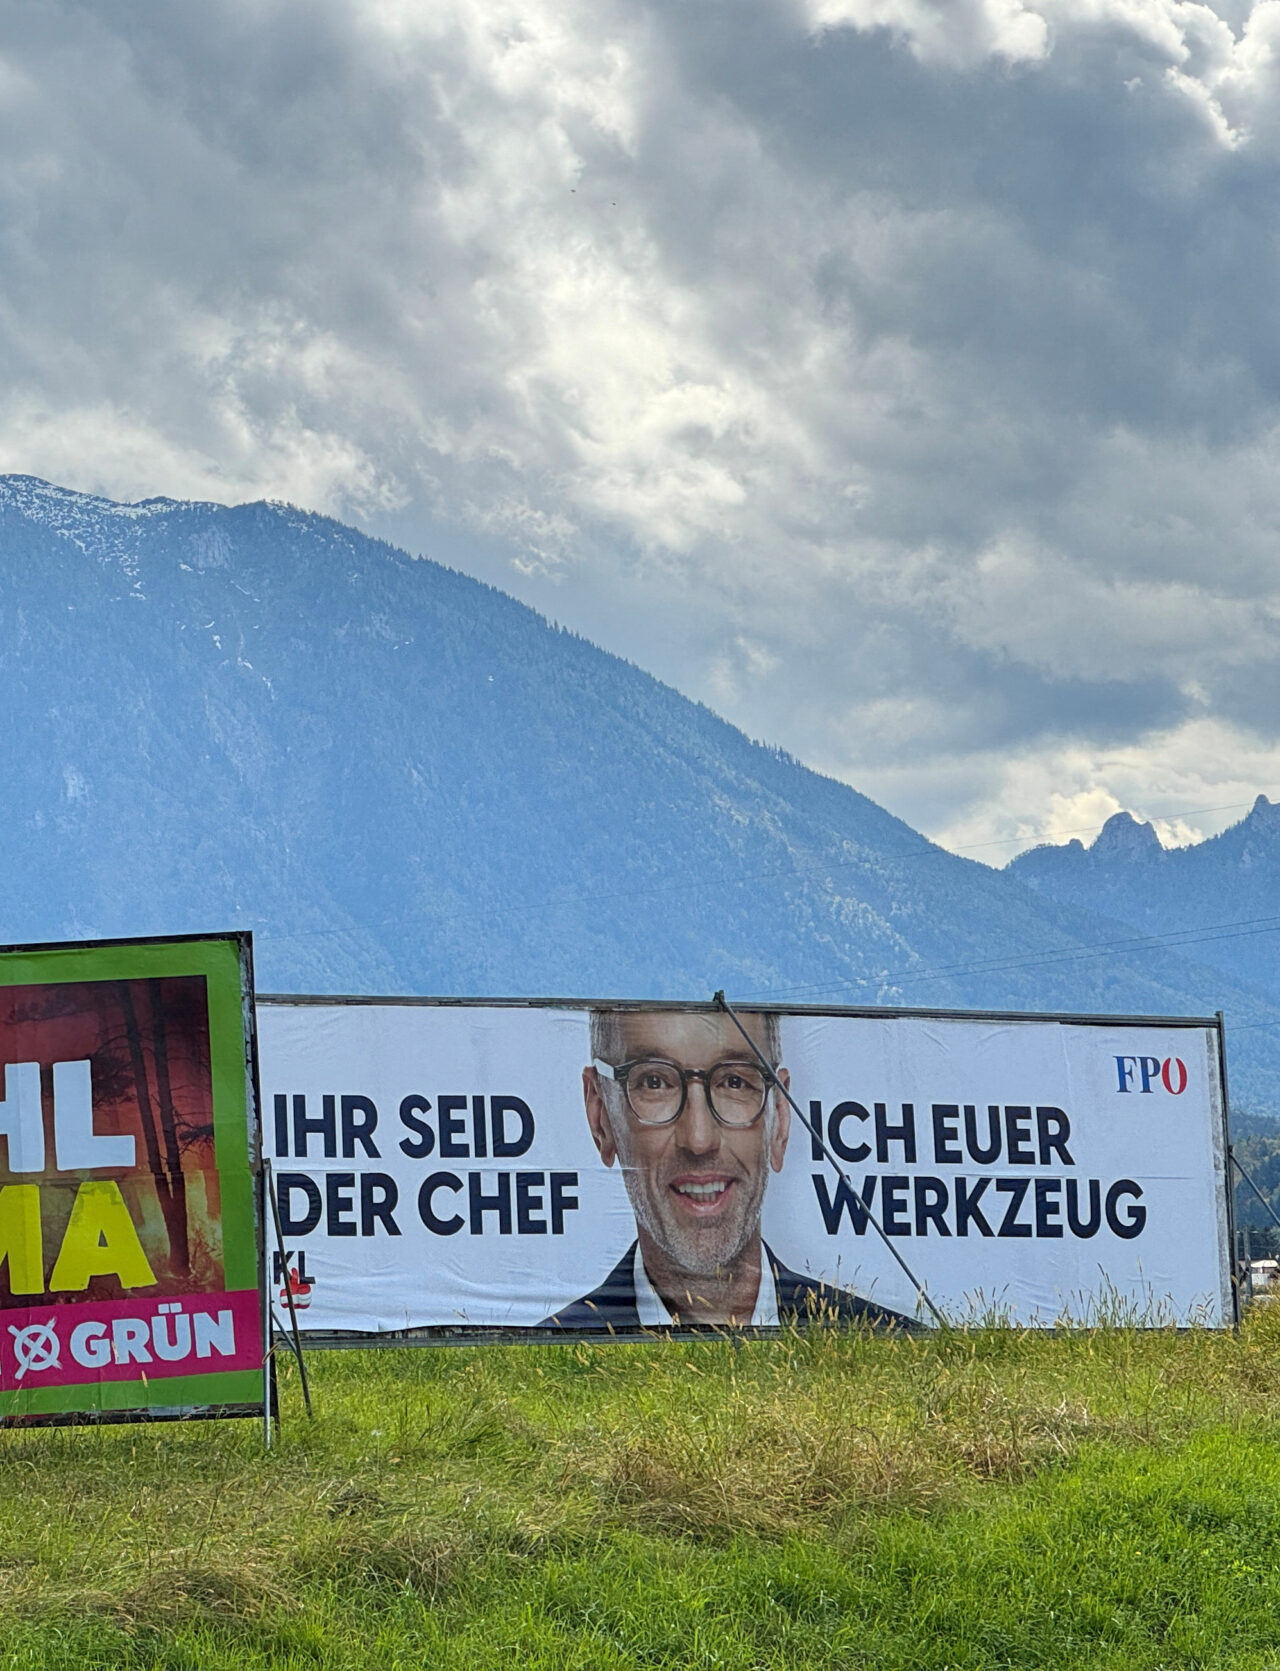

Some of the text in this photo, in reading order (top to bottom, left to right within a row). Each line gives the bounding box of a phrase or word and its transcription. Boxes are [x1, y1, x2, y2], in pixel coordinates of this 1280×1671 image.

[273, 1094, 535, 1158] IHR SEID
[809, 1100, 1076, 1165] ICH EUER
[276, 1171, 579, 1236] DER CHEF
[811, 1174, 1147, 1239] WERKZEUG
[70, 1302, 236, 1369] GRÜN
